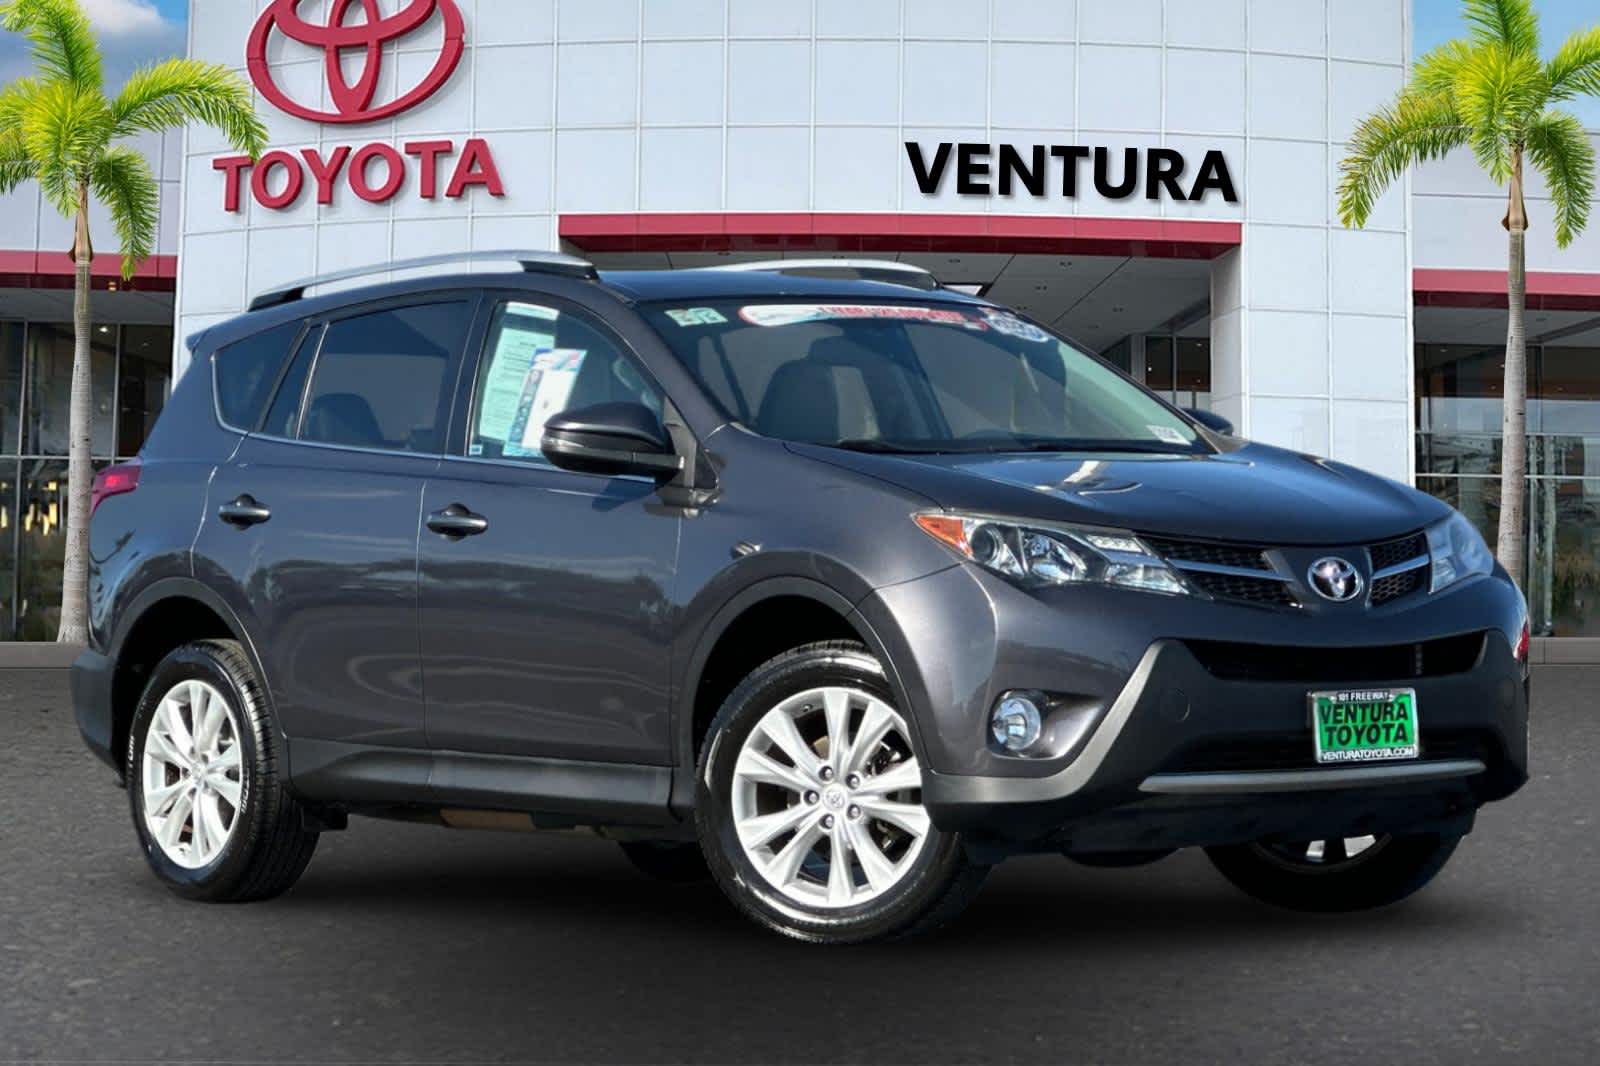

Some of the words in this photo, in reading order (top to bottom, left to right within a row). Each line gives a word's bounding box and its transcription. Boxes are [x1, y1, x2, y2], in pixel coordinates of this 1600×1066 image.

[212, 138, 505, 212] TOYOTA
[904, 141, 1239, 203] VENTURA
[1350, 691, 1388, 701] FREEWAY
[1320, 702, 1408, 724] VENTURA
[1324, 723, 1408, 747] TOYOTA
[1322, 747, 1413, 760] VENTURATOYOTA.COM
